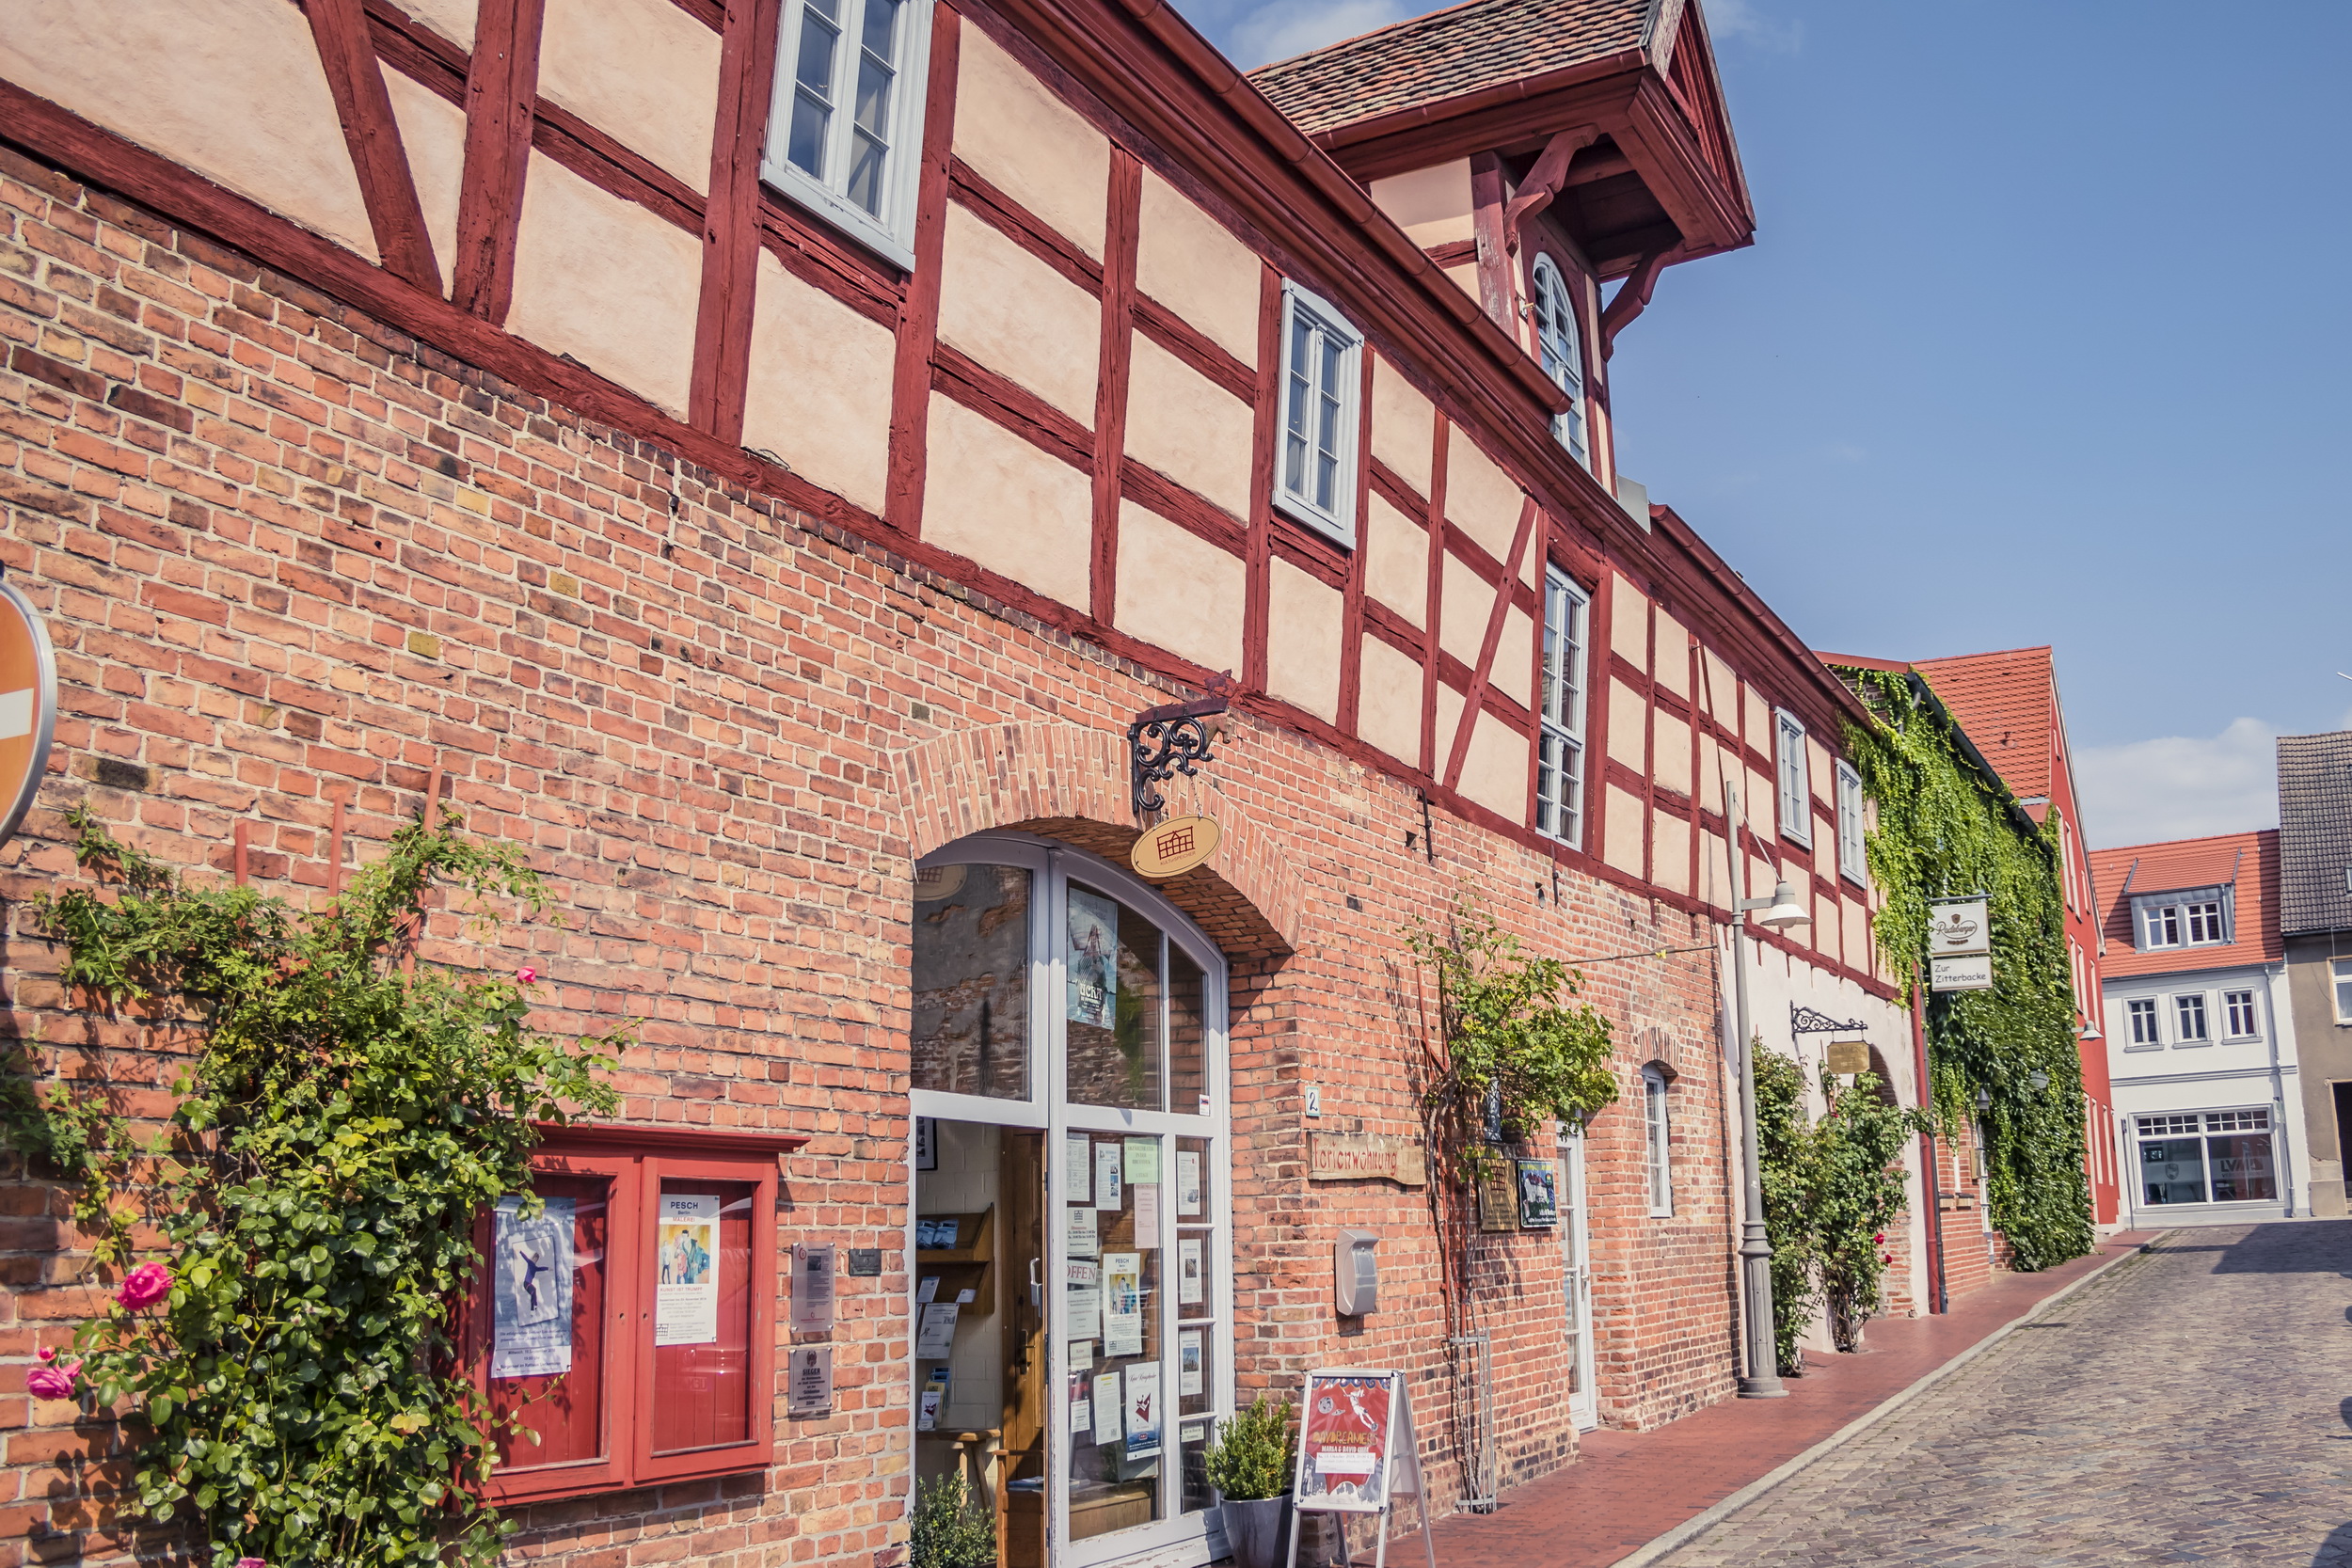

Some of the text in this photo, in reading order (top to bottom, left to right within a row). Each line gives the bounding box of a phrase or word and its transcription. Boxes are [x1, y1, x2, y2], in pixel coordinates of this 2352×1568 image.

[1936, 921, 1978, 936] Radeberger
[1935, 973, 1986, 983] Zitterbacke
[1309, 1091, 1318, 1111] 2
[1312, 1137, 1398, 1176] Ferienwohnung
[670, 1201, 699, 1210] PESCH
[1312, 1430, 1378, 1446] DAYDREAMERS
